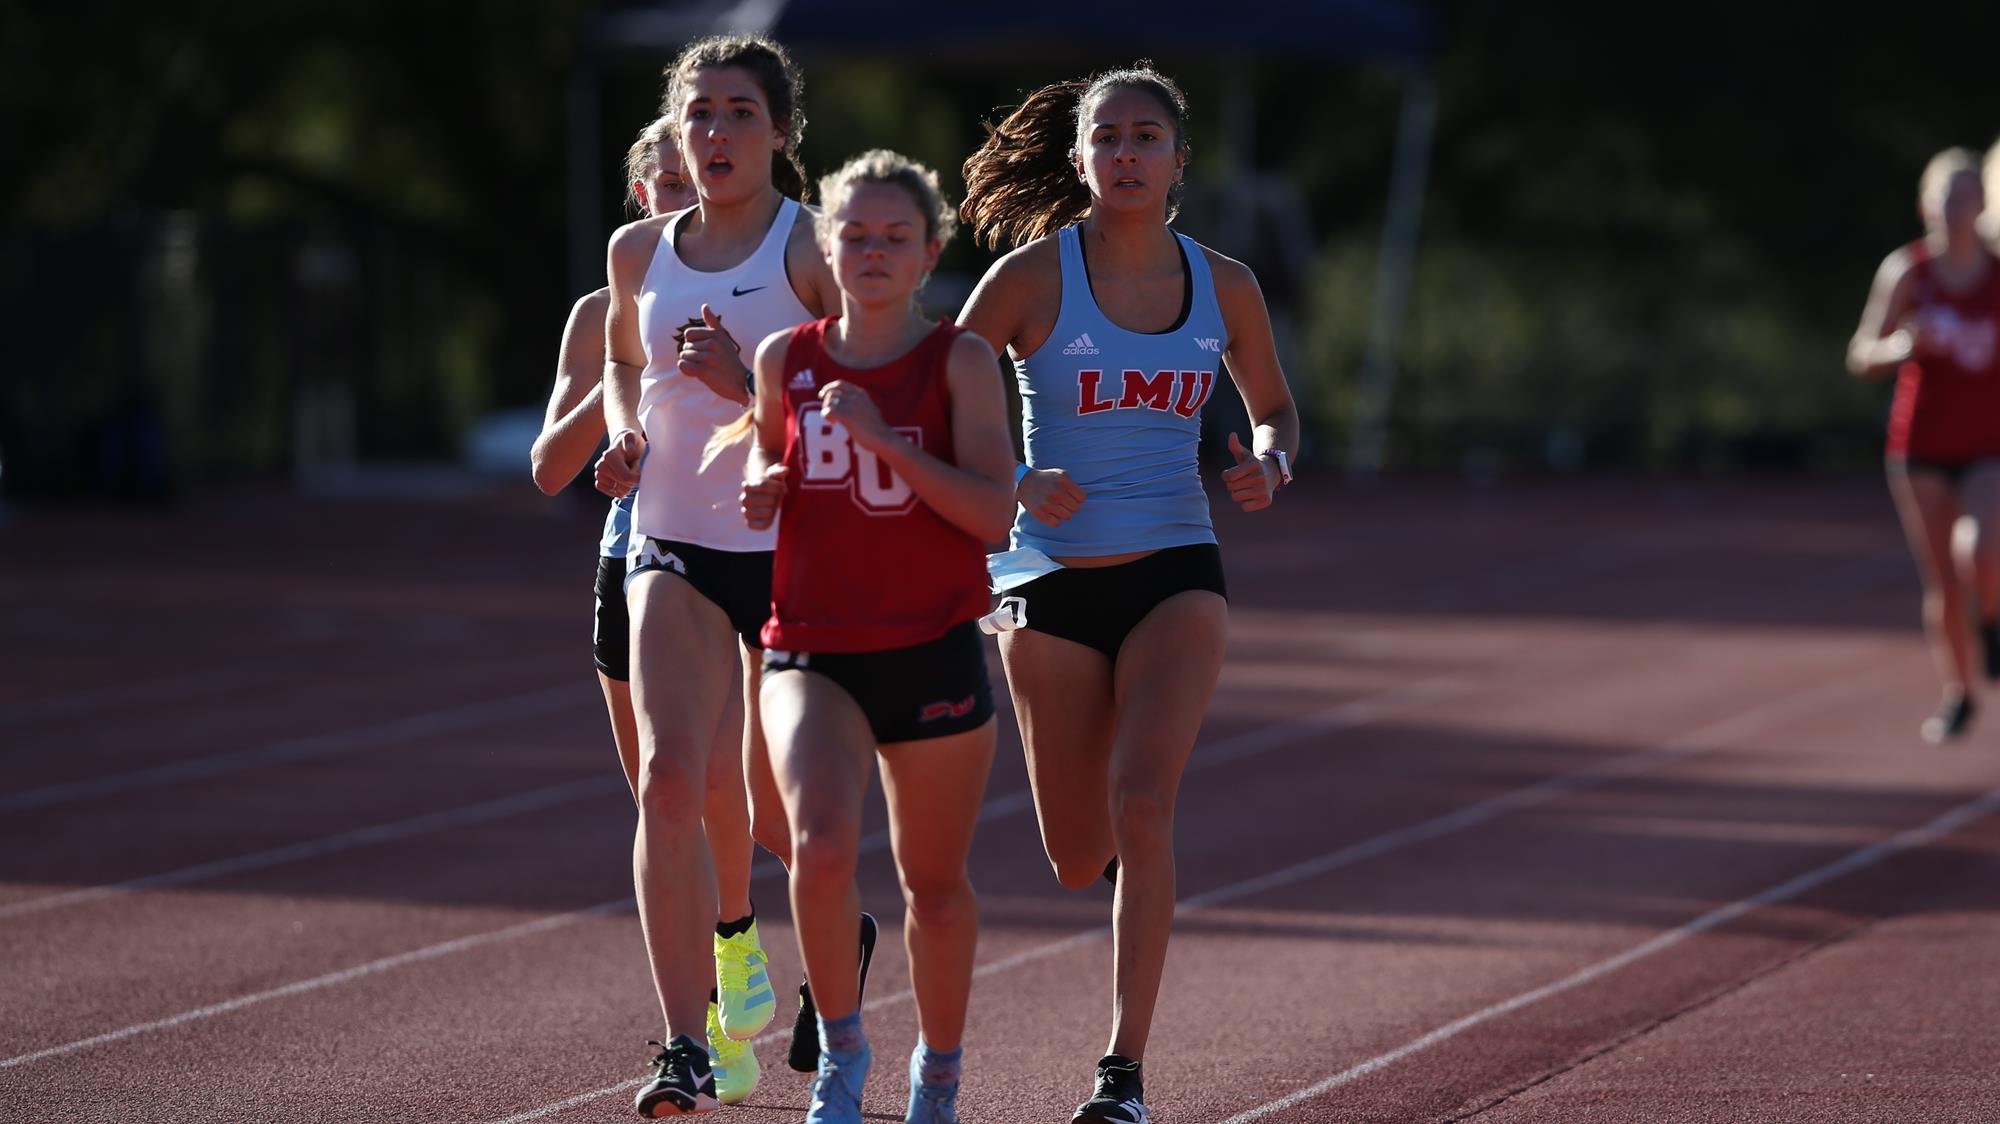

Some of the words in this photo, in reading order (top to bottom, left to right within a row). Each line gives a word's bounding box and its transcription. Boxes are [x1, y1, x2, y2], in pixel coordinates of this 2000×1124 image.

[1062, 346, 1100, 355] adidas
[1077, 369, 1213, 419] LMU
[798, 401, 923, 516] BU
